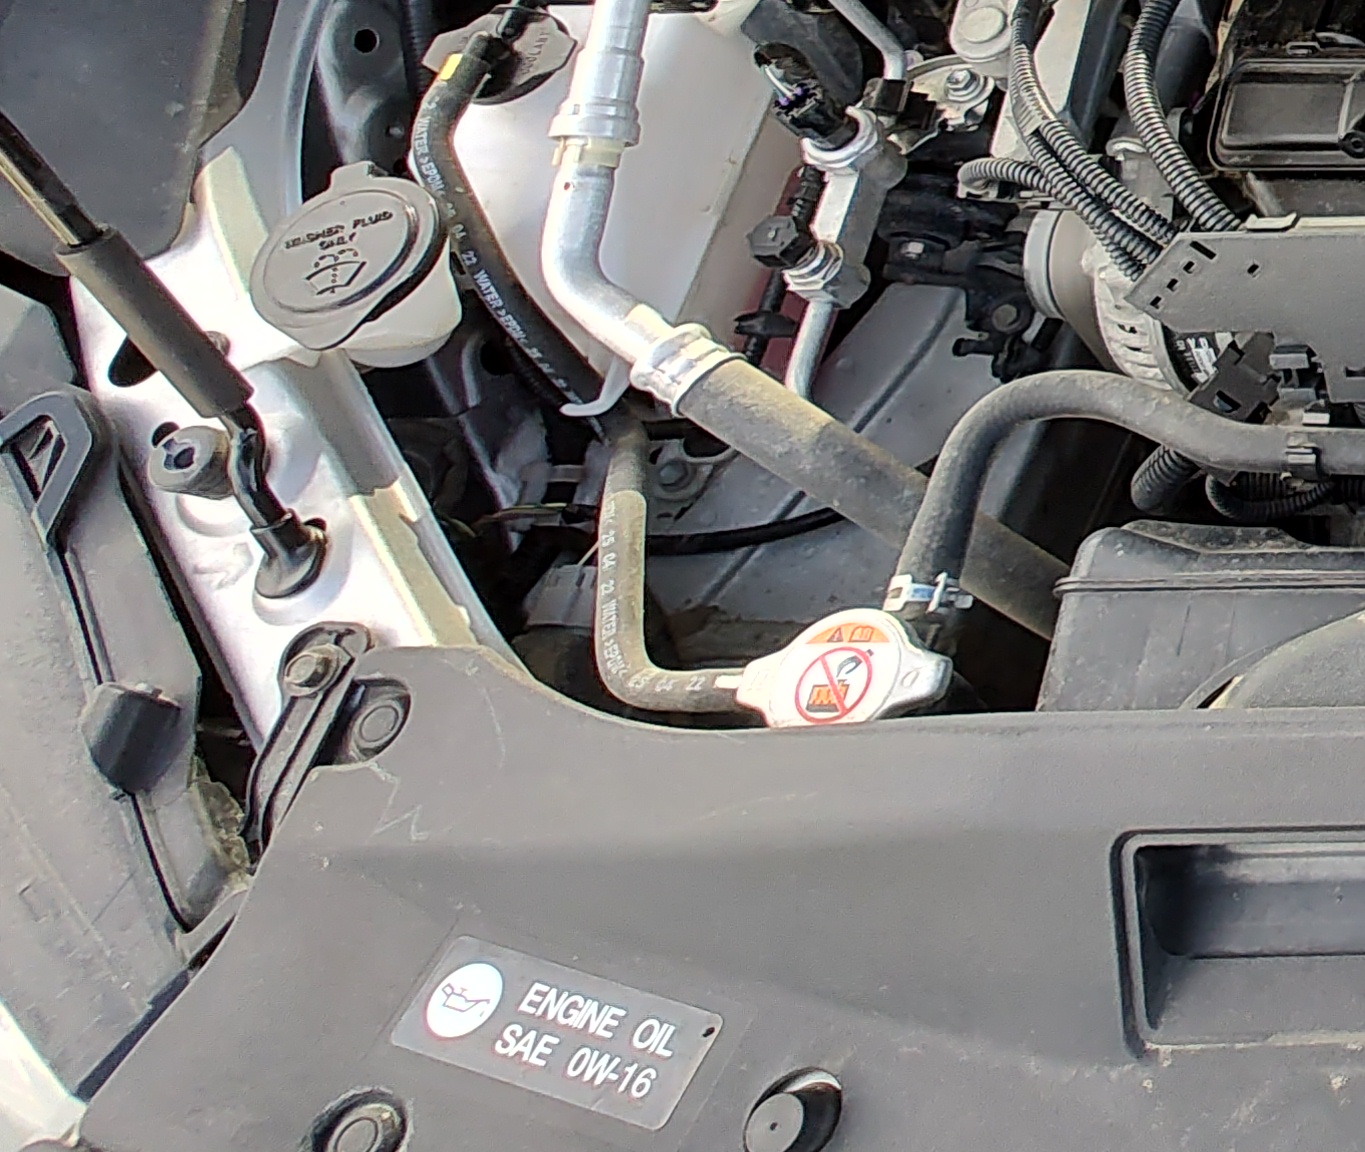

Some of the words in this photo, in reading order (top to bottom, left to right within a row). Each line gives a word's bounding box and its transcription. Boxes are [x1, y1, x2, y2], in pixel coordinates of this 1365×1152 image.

[415, 116, 430, 157] WATER
[461, 250, 478, 267] 22
[473, 268, 505, 314] WATER
[601, 599, 619, 640] WATER
[686, 675, 706, 692] 22
[494, 1023, 560, 1068] SAE
[567, 1046, 658, 1099] 0W-16
[517, 981, 627, 1040] ENGINE
[632, 1016, 677, 1060] OIL
